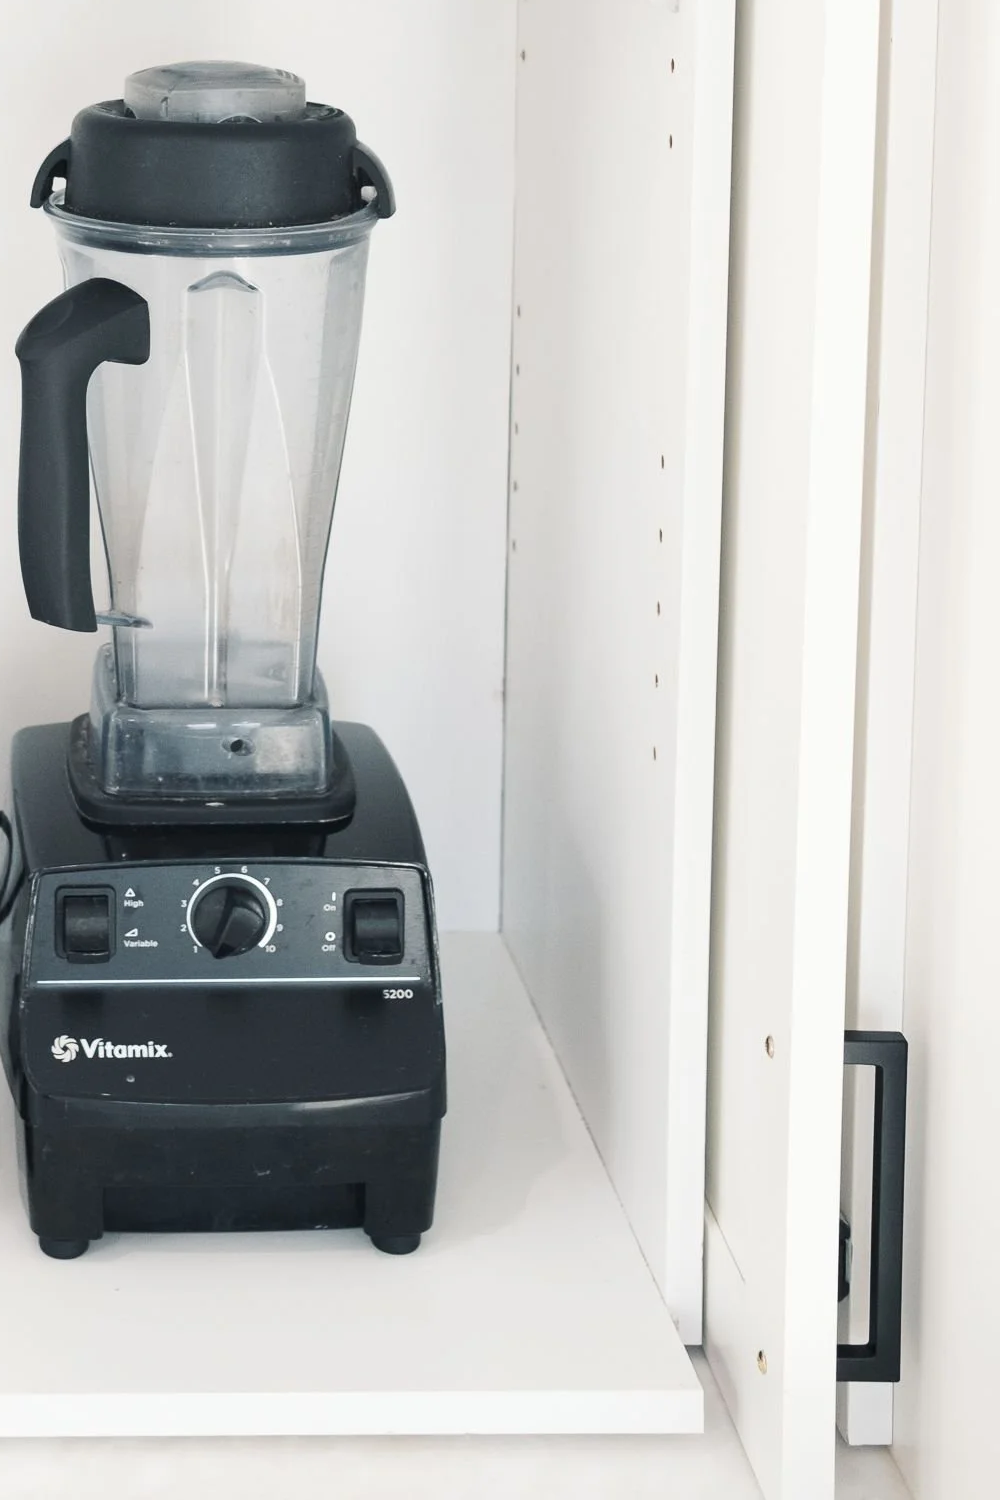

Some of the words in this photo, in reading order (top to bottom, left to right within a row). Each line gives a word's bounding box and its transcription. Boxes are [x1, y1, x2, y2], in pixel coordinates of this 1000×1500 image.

[123, 900, 145, 909] High
[181, 900, 188, 908] 3
[276, 898, 284, 906] 8
[323, 903, 336, 911] On
[180, 924, 187, 932] 2
[276, 924, 284, 932] 9
[123, 939, 159, 948] Variable
[265, 945, 276, 953] 10
[321, 944, 337, 952] Off
[382, 989, 415, 999] 5200
[80, 1038, 168, 1059] Vitamix
